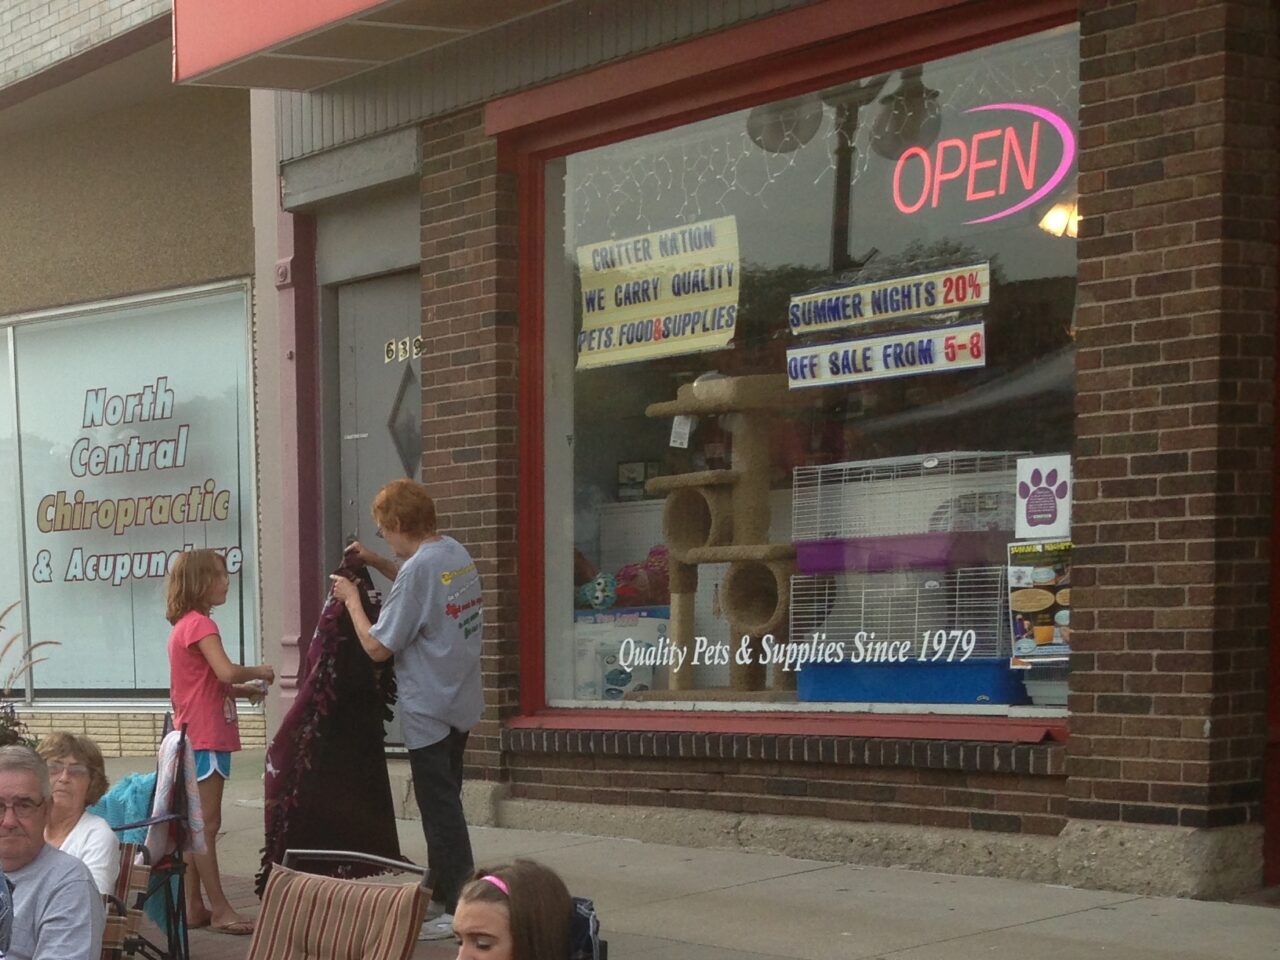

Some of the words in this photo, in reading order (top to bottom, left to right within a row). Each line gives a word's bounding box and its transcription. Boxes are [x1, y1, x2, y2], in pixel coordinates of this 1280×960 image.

[893, 121, 1040, 214] OPEN
[591, 238, 653, 272] CRITTER
[658, 224, 716, 257] NATION
[584, 288, 605, 313] WE
[614, 277, 660, 308] CARRY
[671, 263, 734, 297] QUALITY
[789, 292, 865, 328] SUMMER
[871, 281, 936, 316] NIGHTS
[942, 271, 981, 305] 20%
[788, 354, 818, 381] OFF
[828, 347, 873, 376] SALE
[882, 339, 935, 369] FROM
[944, 331, 982, 362] 5-8
[82, 376, 175, 428] North
[70, 424, 190, 478] Central
[36, 478, 231, 536] Chiropractic
[32, 549, 53, 583] &
[619, 636, 687, 673] Quality
[691, 636, 730, 666] Pets
[735, 634, 753, 665] &
[758, 632, 845, 672] Supplies
[851, 631, 911, 663] Since
[917, 629, 976, 662] 1979
